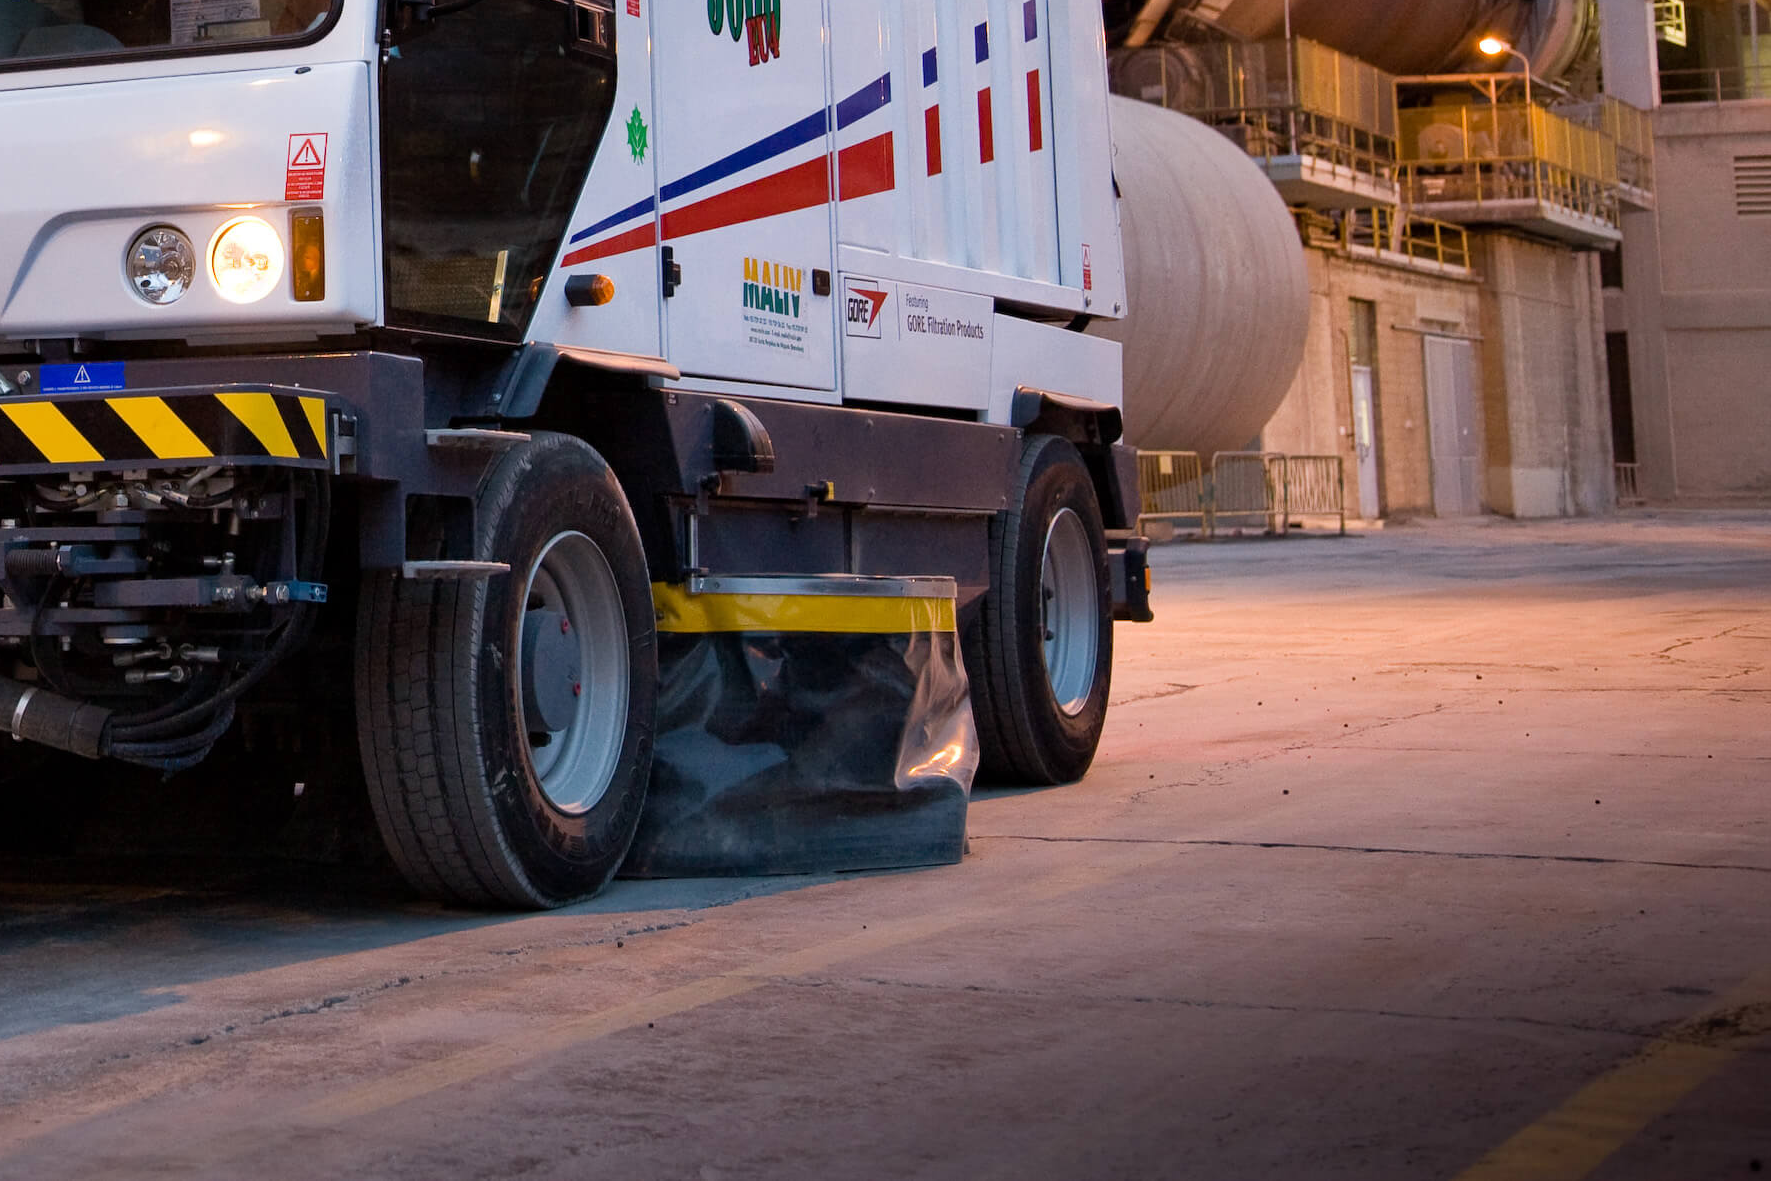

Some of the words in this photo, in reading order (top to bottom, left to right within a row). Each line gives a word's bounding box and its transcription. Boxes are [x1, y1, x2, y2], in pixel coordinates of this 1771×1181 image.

[848, 297, 869, 324] GORE
[928, 316, 956, 336] Filtration
[957, 319, 985, 340] Products
